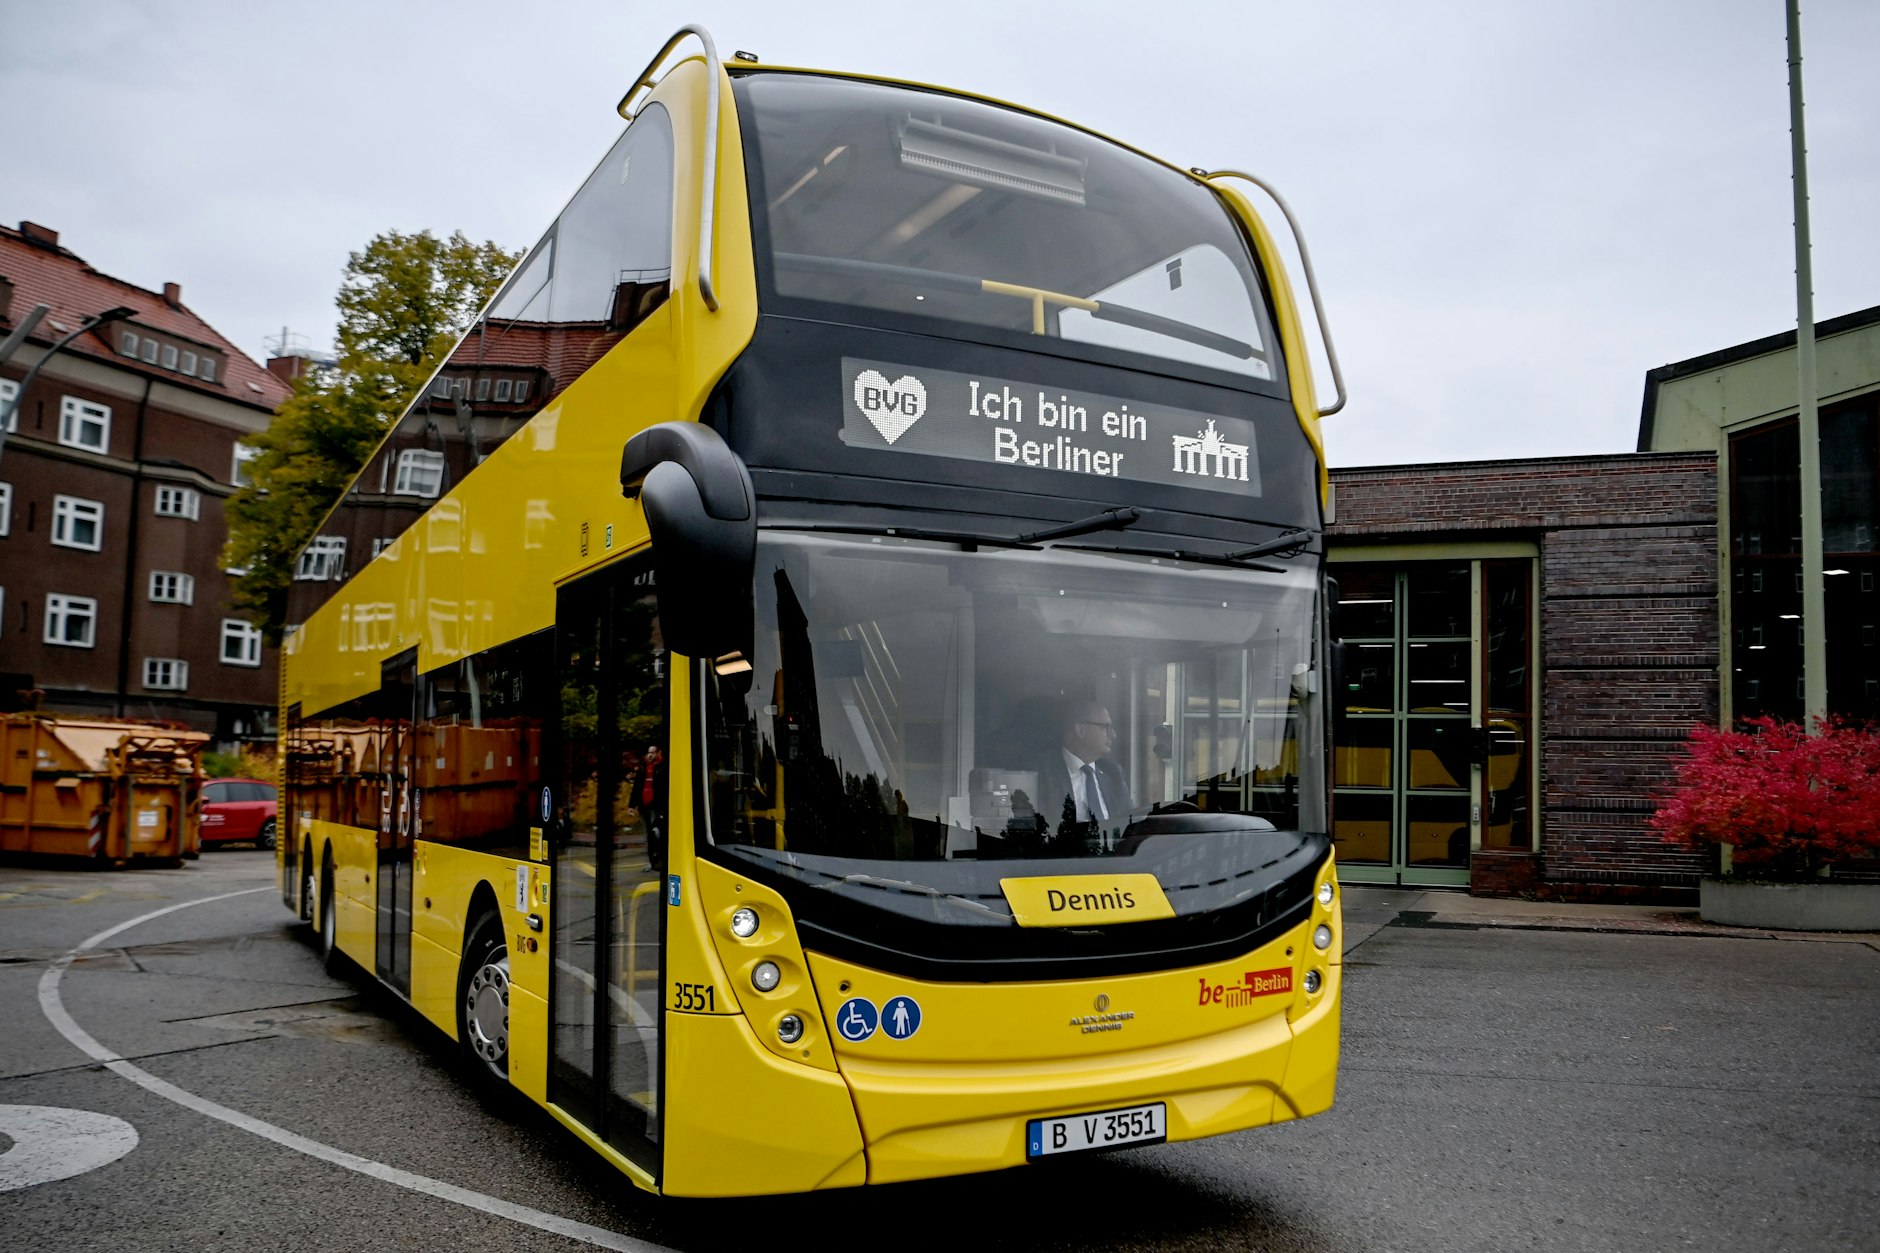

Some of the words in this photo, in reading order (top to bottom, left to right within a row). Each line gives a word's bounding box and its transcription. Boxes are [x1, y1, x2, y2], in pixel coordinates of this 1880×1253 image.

[863, 386, 919, 417] BVG
[968, 380, 1023, 422] Ich
[1038, 391, 1087, 431] bin
[1101, 405, 1148, 441] ein
[994, 426, 1125, 477] Berliner
[1047, 887, 1135, 912] Dennis
[674, 981, 716, 1012] 3551
[1198, 978, 1225, 1007] be
[1254, 974, 1289, 994] Berlin
[1069, 1010, 1135, 1027] ALEXANDER
[1081, 1022, 1123, 1035] DENNIS
[1053, 1123, 1067, 1149] B
[1083, 1118, 1097, 1144] V
[1104, 1110, 1156, 1142] 3551
[1033, 1143, 1040, 1151] D
